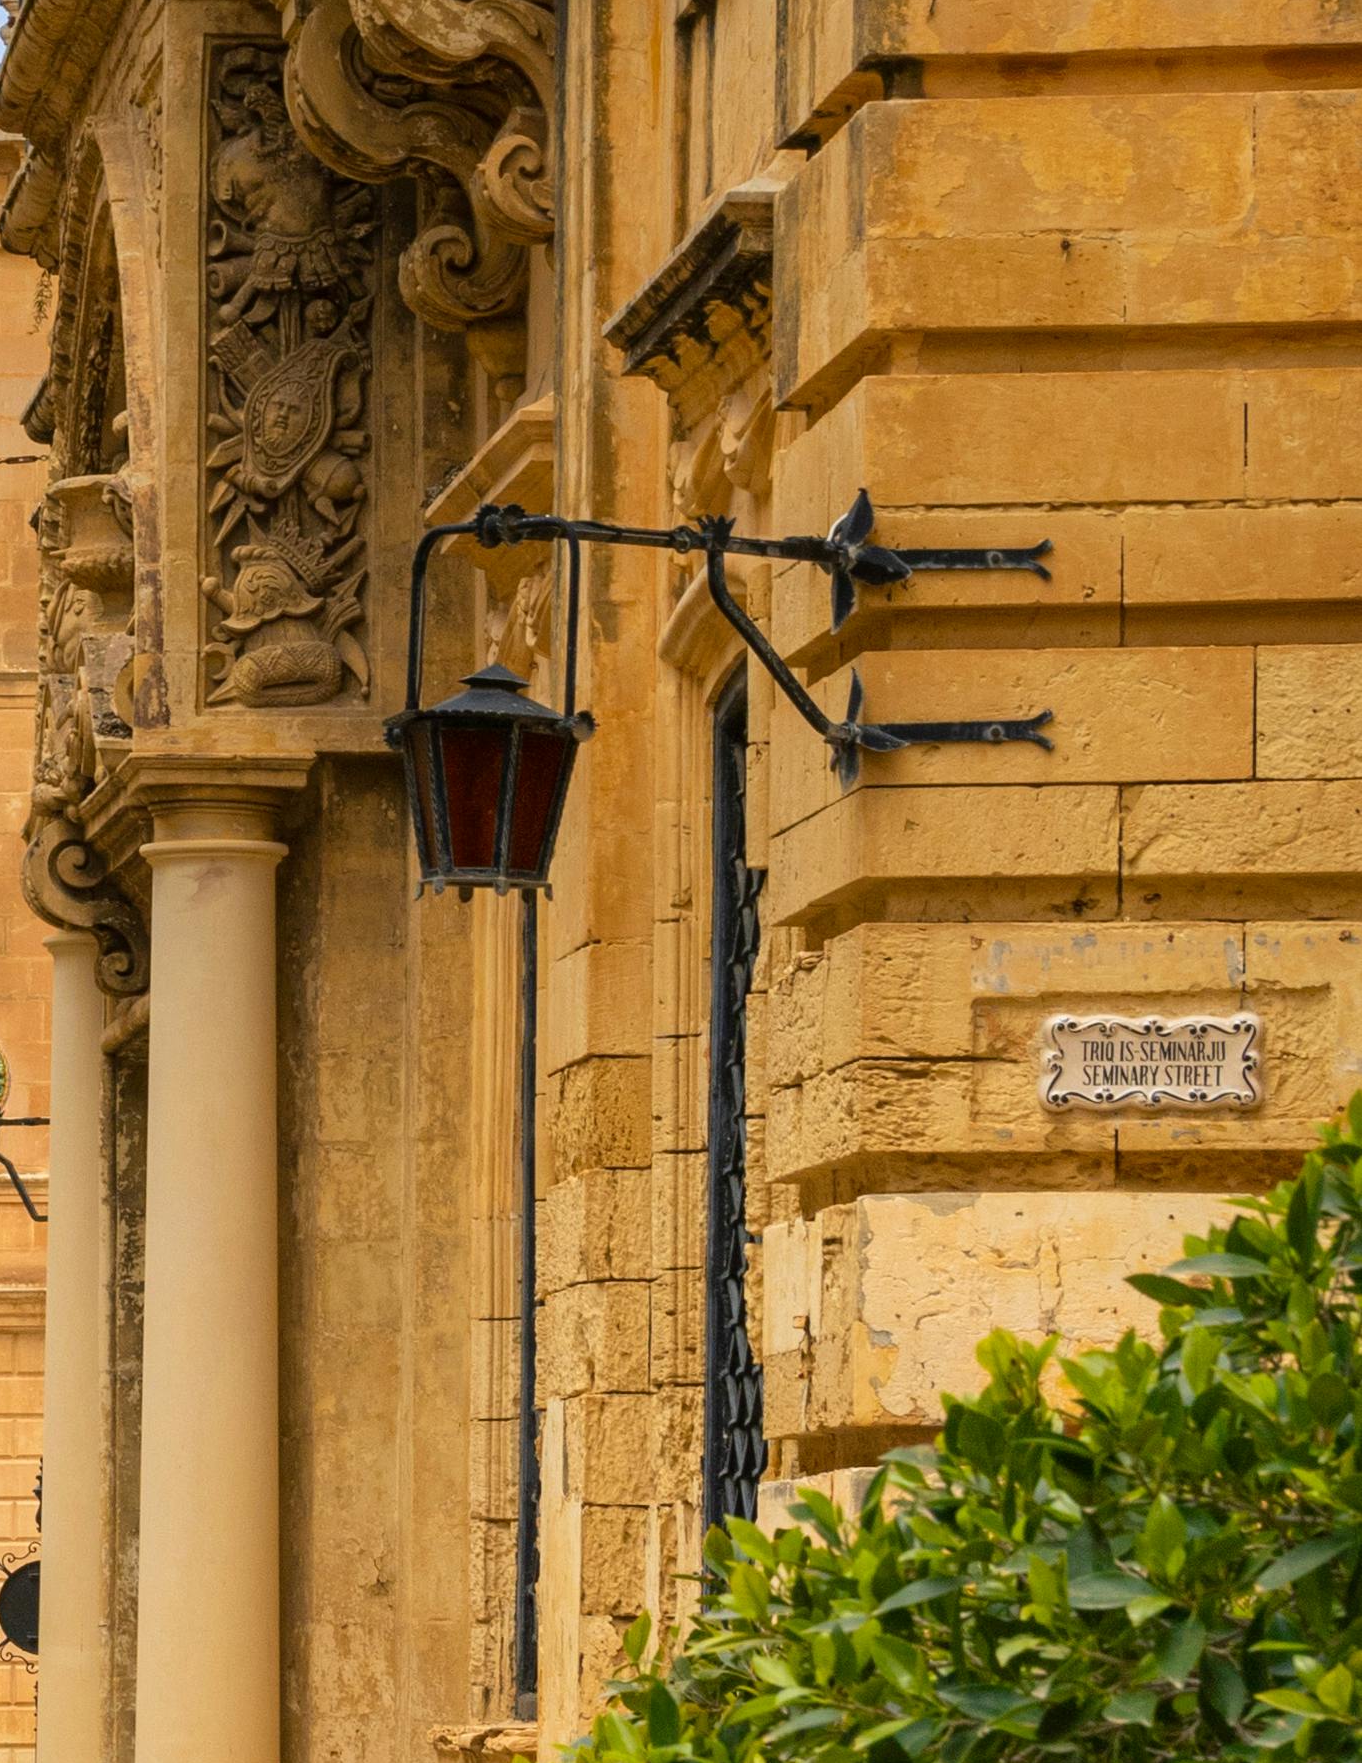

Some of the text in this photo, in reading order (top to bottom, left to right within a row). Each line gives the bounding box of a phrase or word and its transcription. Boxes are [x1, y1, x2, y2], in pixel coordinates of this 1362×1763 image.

[1081, 1040, 1226, 1063] TRIQ IS-SEMINARJU
[1083, 1064, 1224, 1086] SEMINARY STREET
